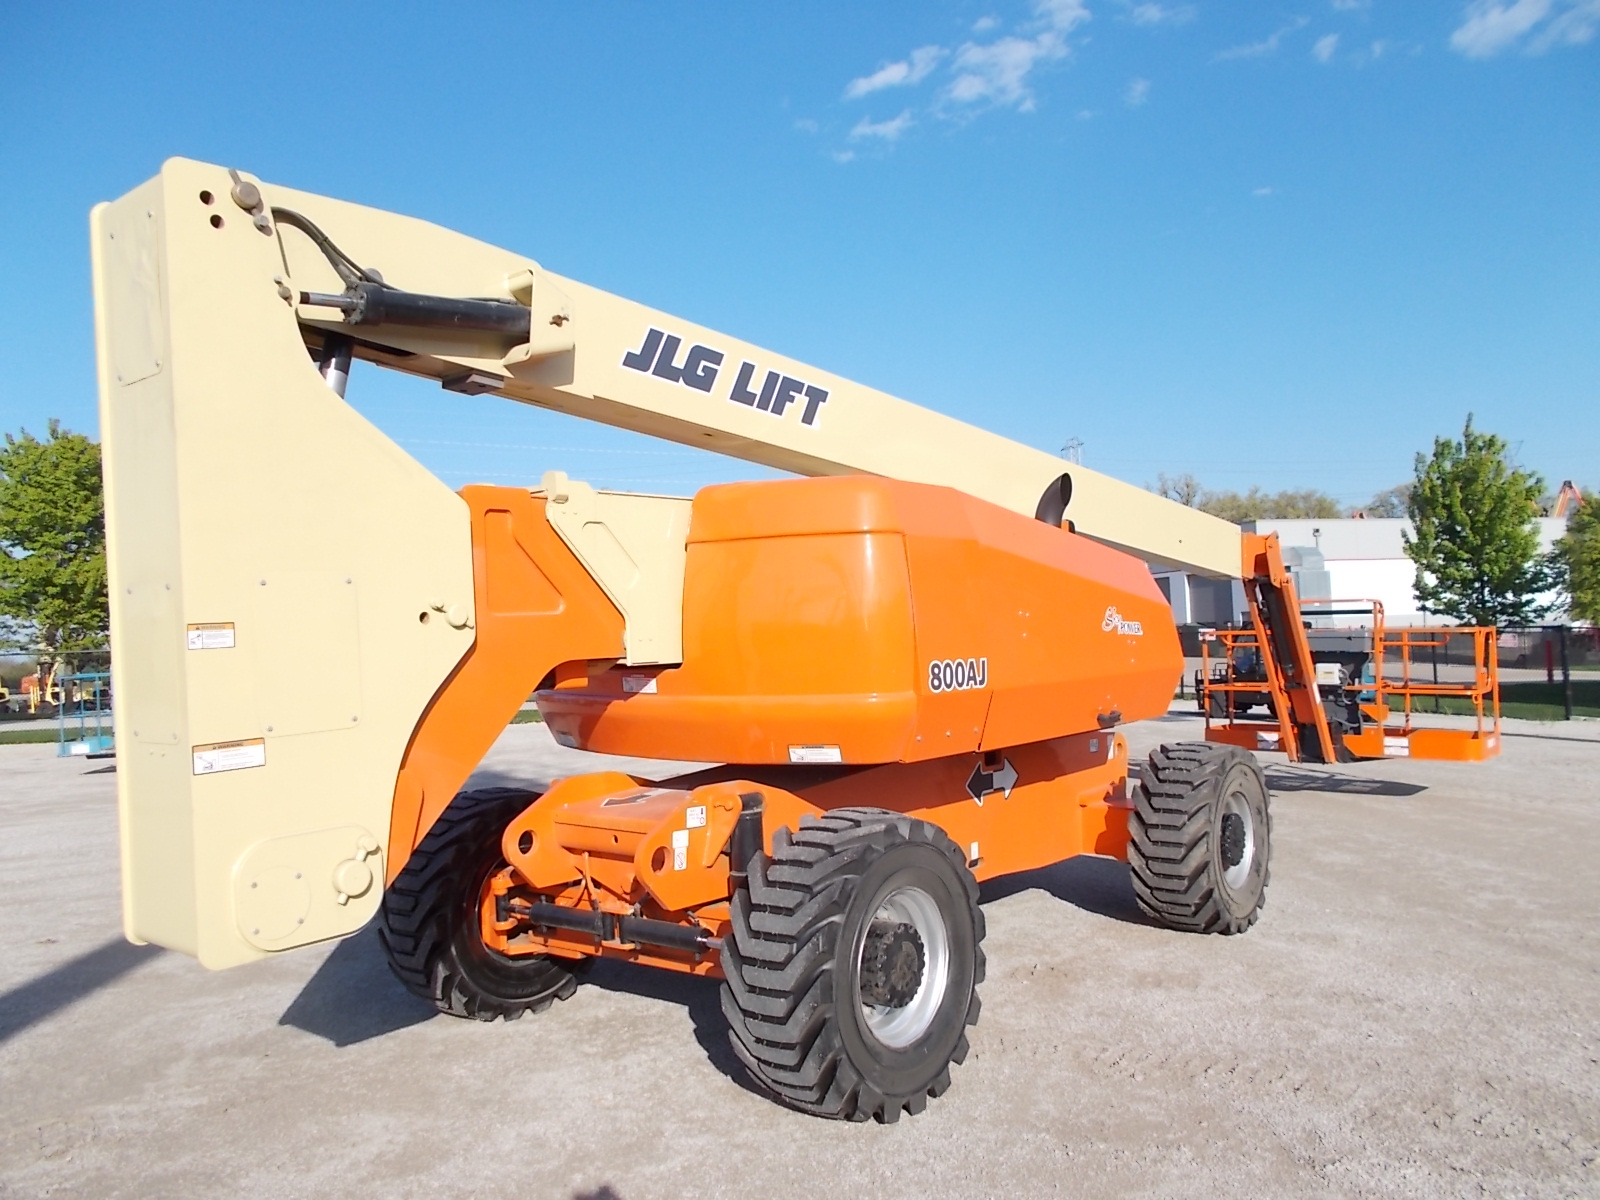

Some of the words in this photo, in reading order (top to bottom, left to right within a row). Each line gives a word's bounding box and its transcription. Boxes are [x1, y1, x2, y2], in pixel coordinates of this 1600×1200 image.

[621, 327, 726, 393] JLG
[729, 361, 830, 426] LIFT
[930, 659, 987, 691] 800AJ
